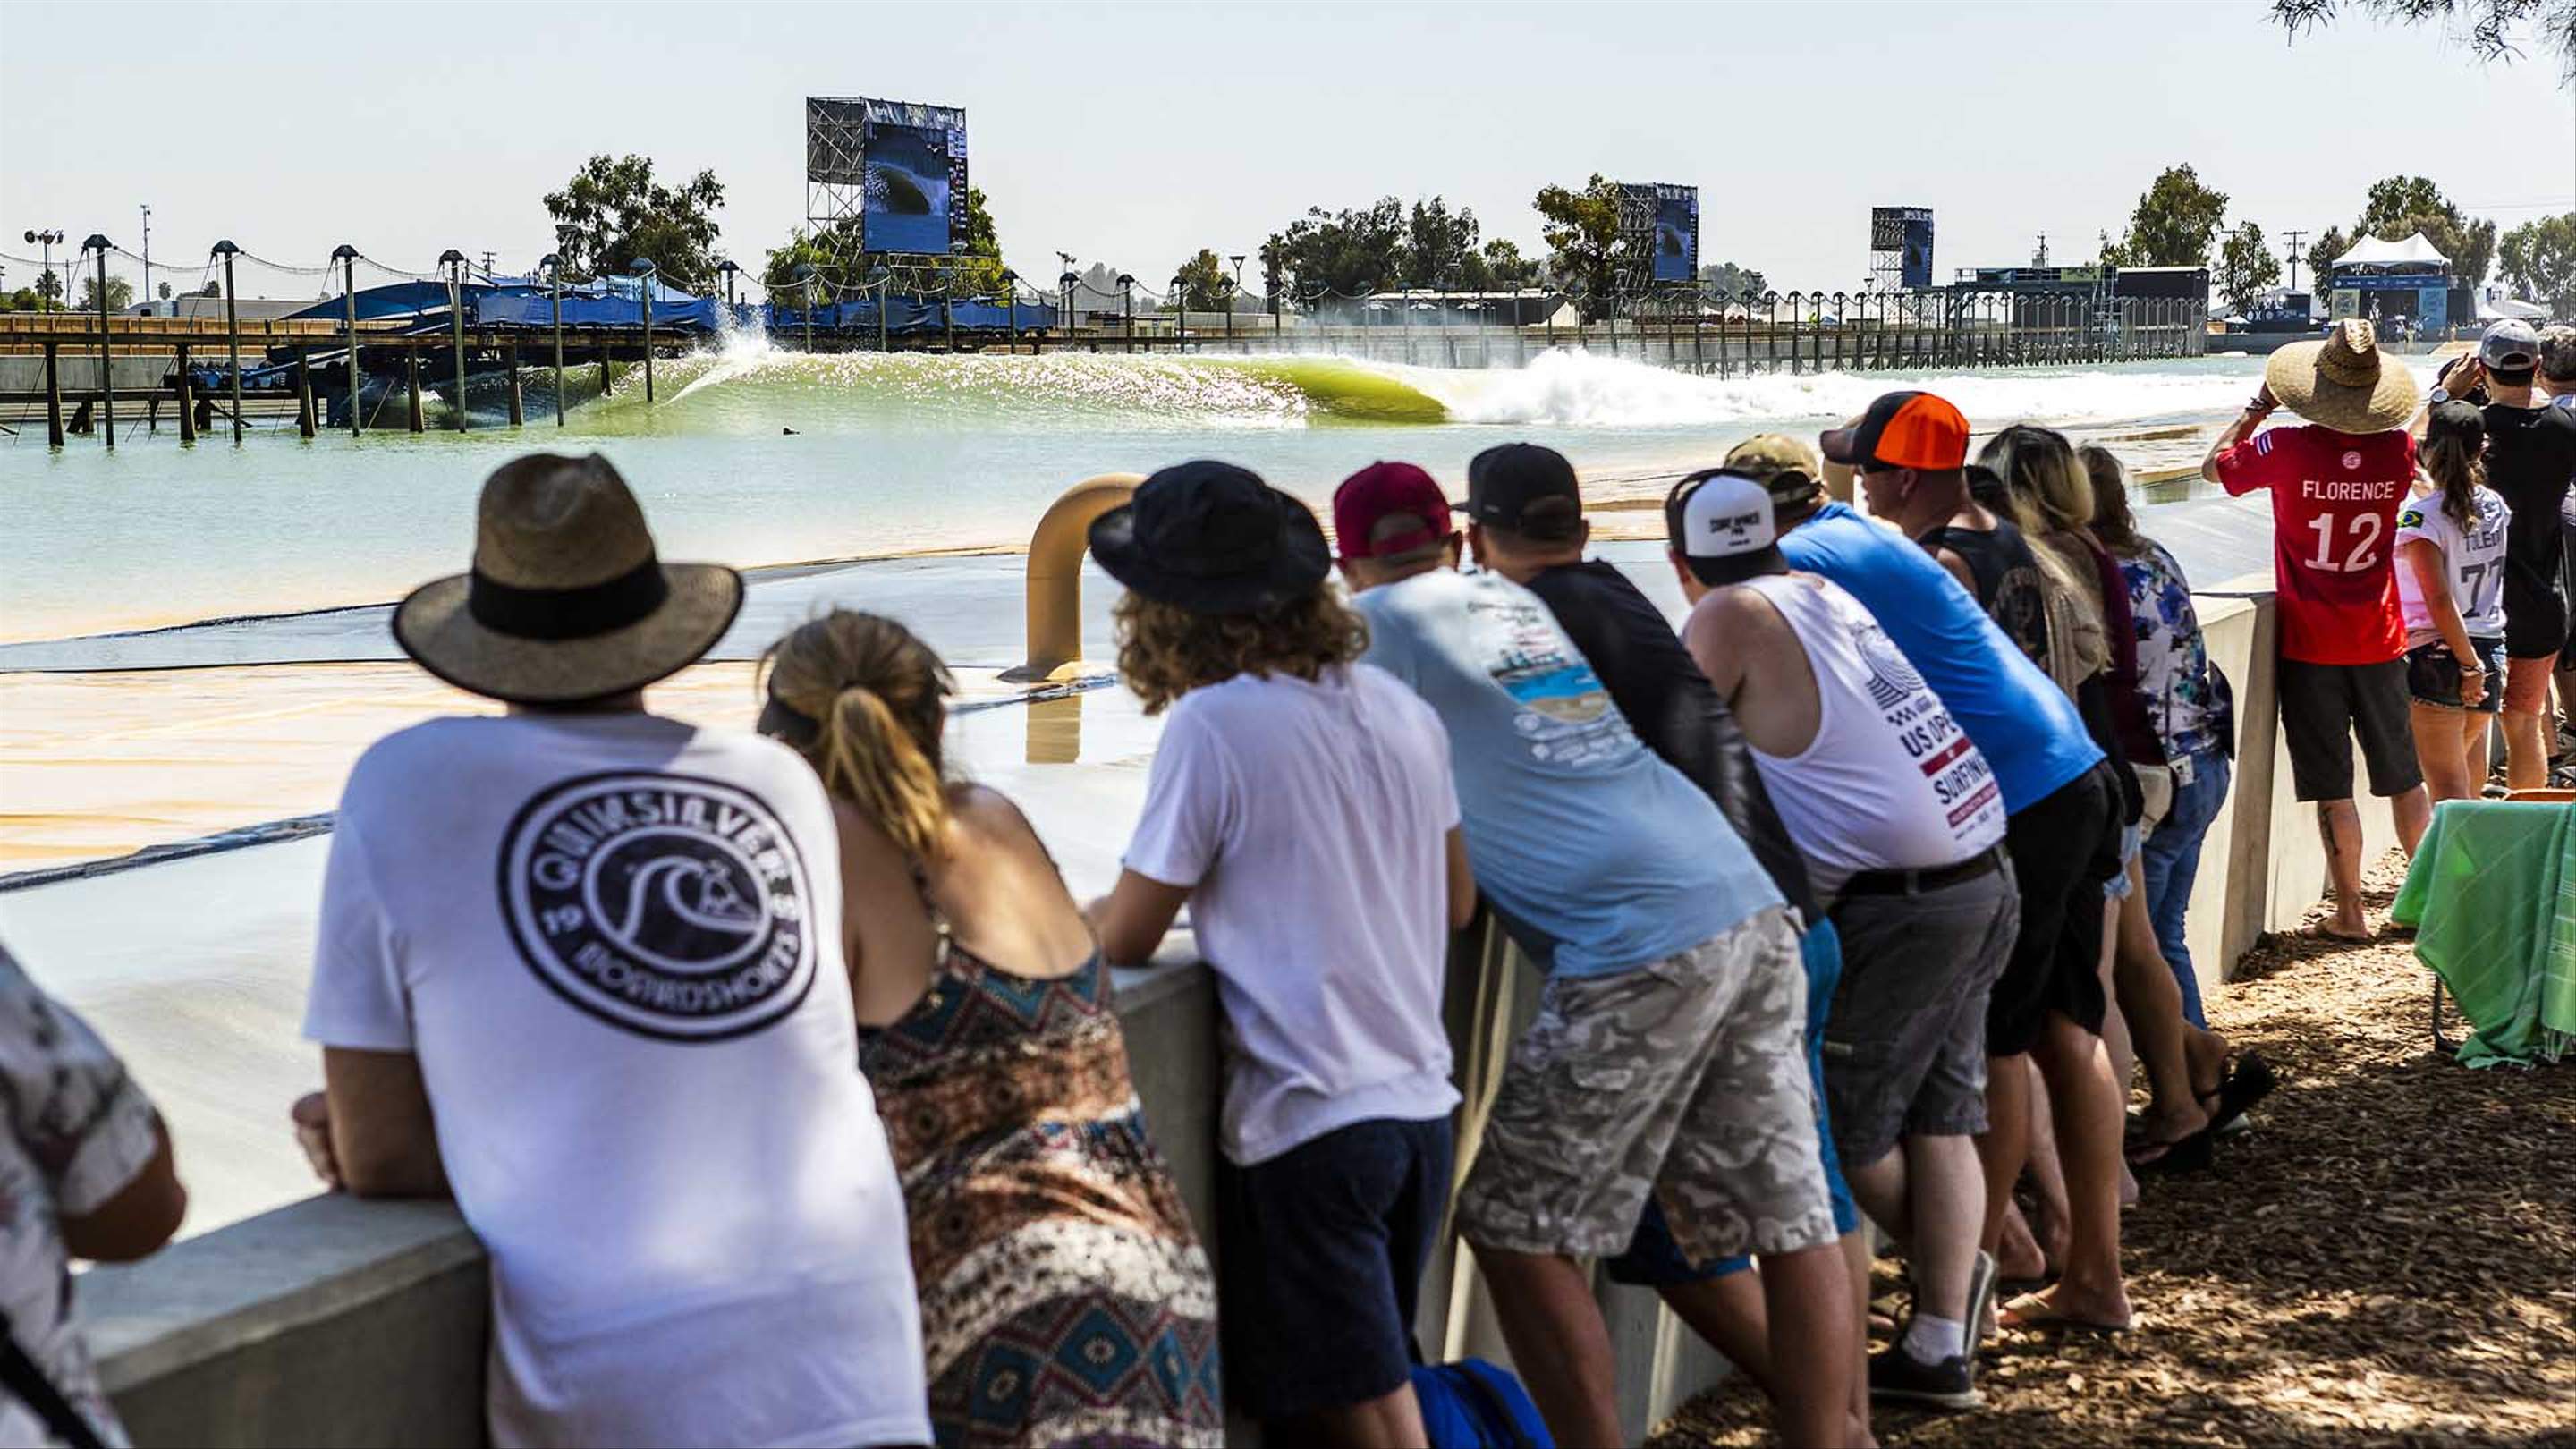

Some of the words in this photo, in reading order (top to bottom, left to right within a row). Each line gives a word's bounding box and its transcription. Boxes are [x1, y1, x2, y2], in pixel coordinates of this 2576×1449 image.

[2302, 480, 2395, 500] FLORENCE
[2304, 513, 2382, 572] 12
[1900, 725, 1934, 758] US
[533, 792, 789, 891] QUIKSILVER
